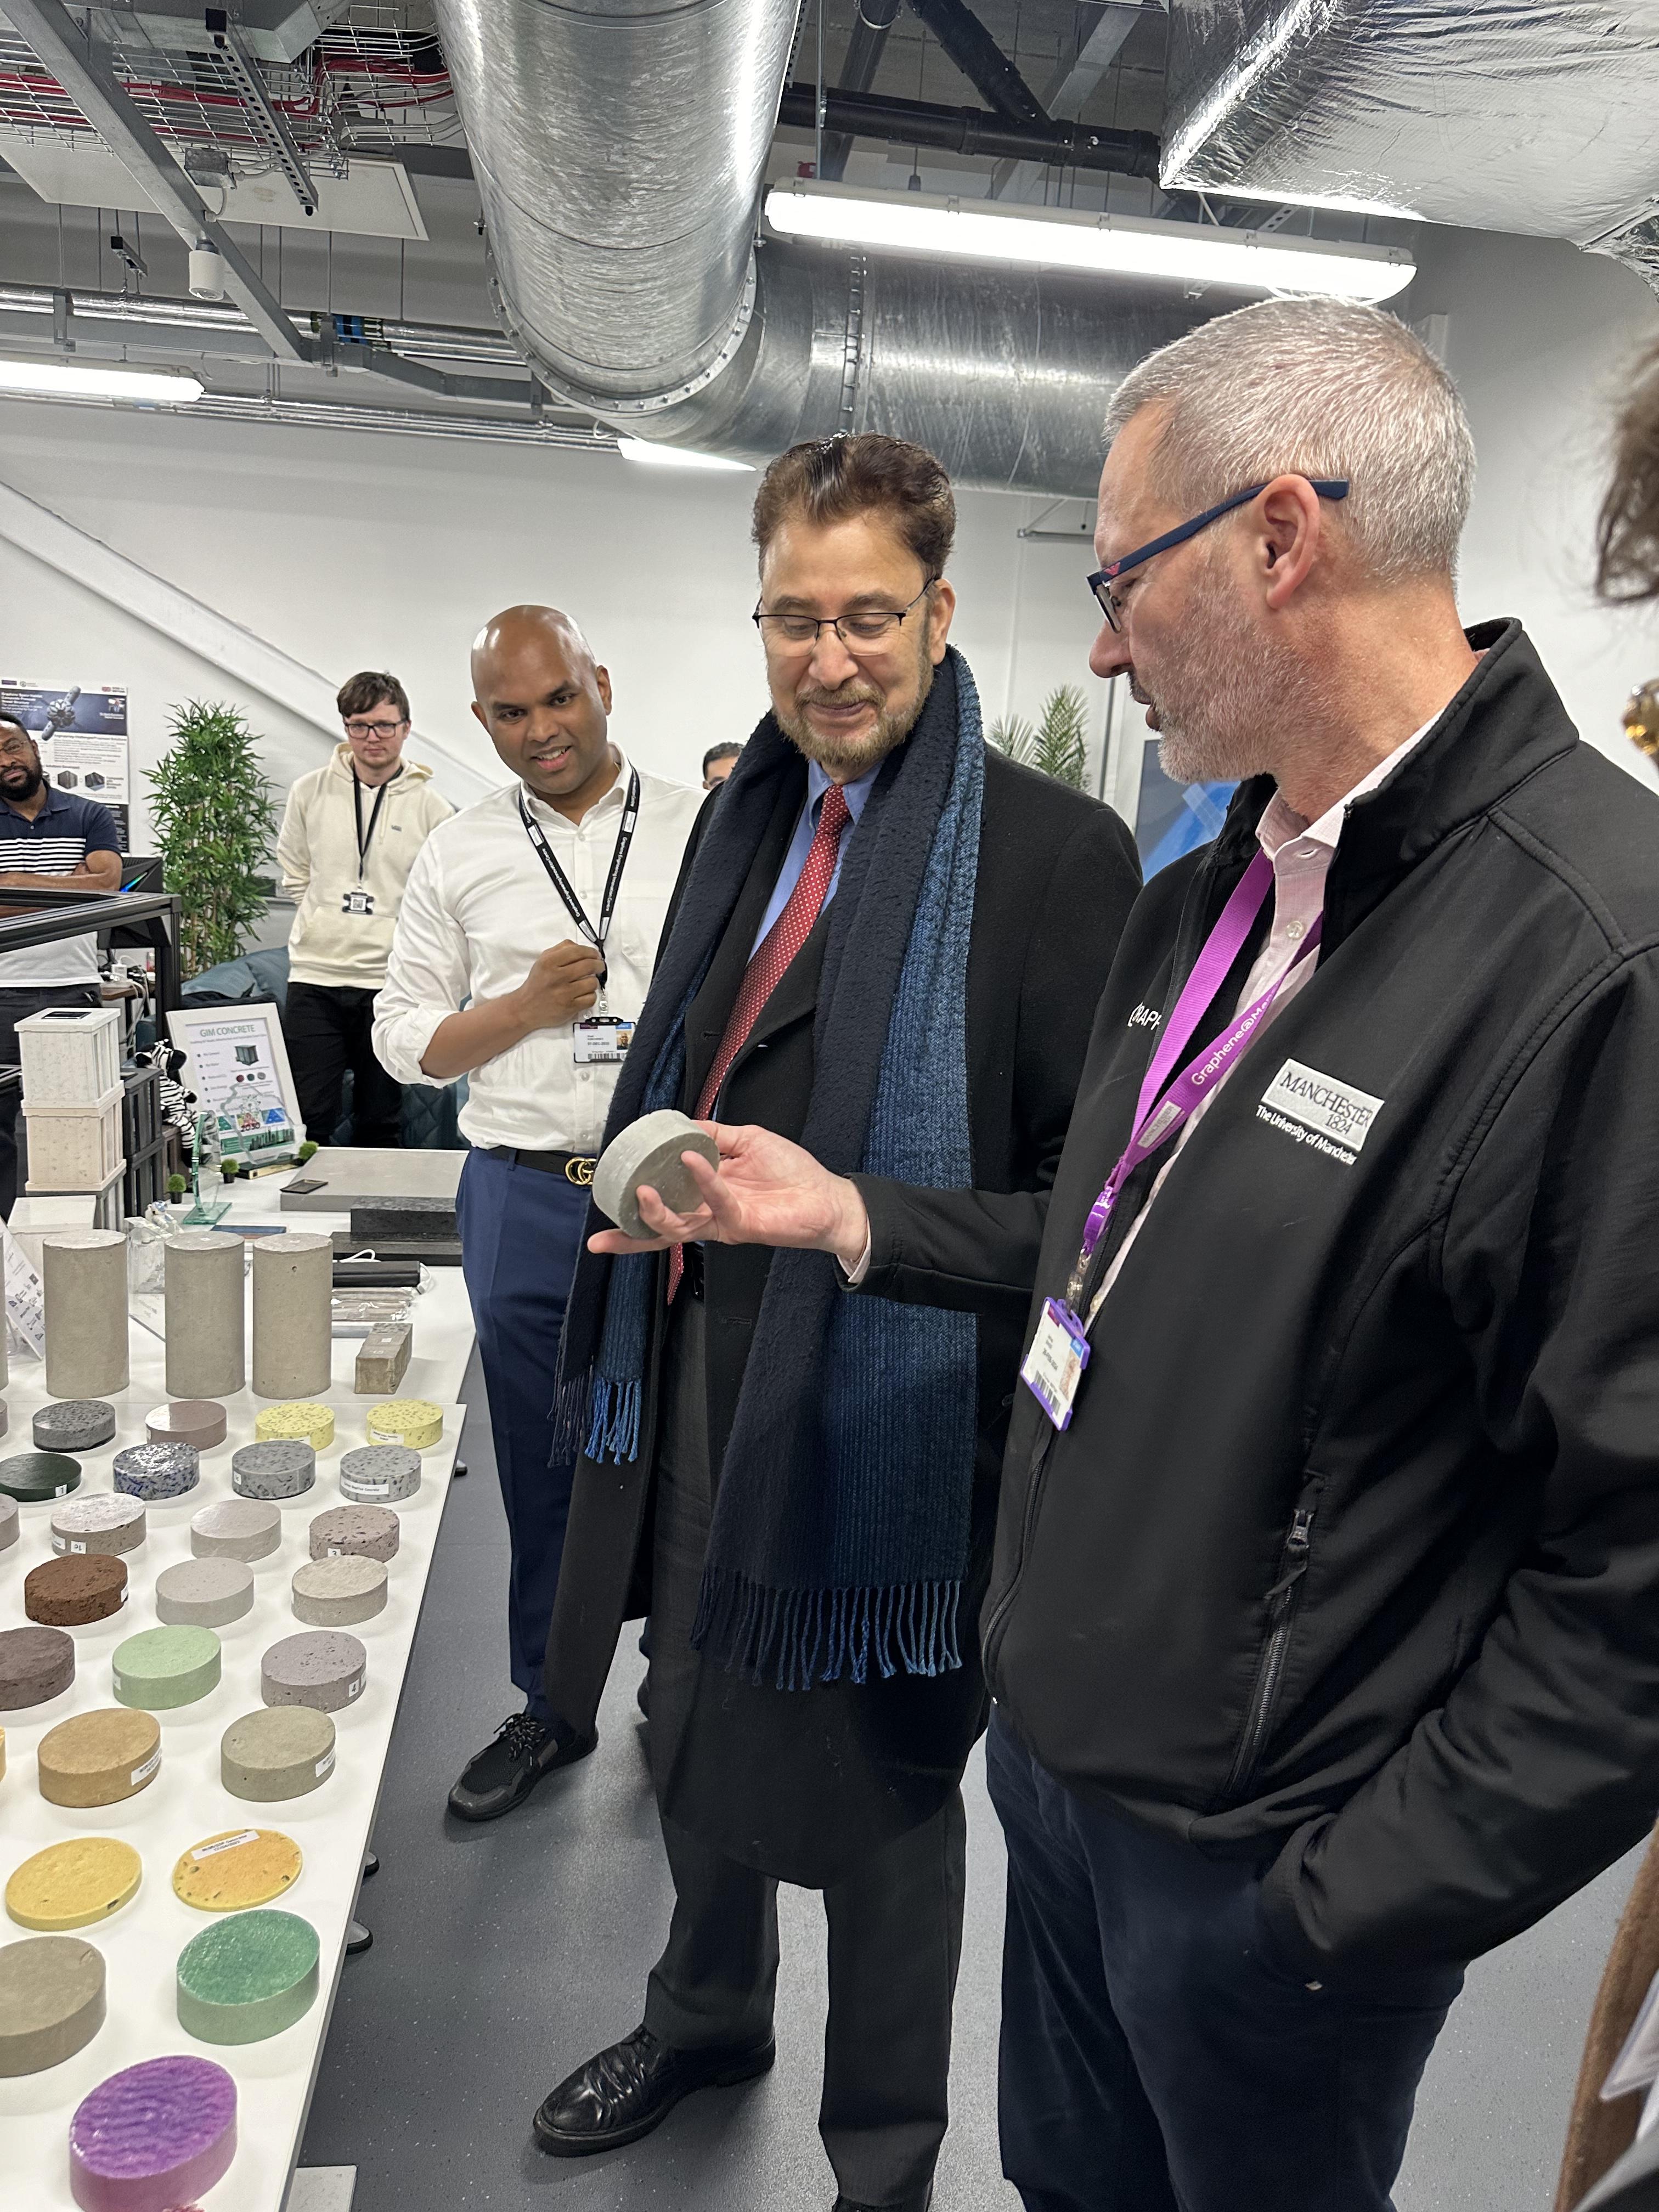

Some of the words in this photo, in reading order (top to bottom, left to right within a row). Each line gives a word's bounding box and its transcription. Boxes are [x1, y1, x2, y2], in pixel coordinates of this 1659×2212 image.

[199, 1029, 216, 1037] GIM
[216, 1024, 256, 1035] CONCRETE
[1280, 1071, 1374, 1128] MANCHESTER
[240, 1121, 261, 1132] 2030
[1325, 1113, 1353, 1135] 1824
[1255, 1104, 1272, 1121] The
[1270, 1112, 1308, 1142] University
[1305, 1132, 1320, 1146] of
[1315, 1136, 1358, 1166] Manchester
[351, 1683, 356, 1692] 4
